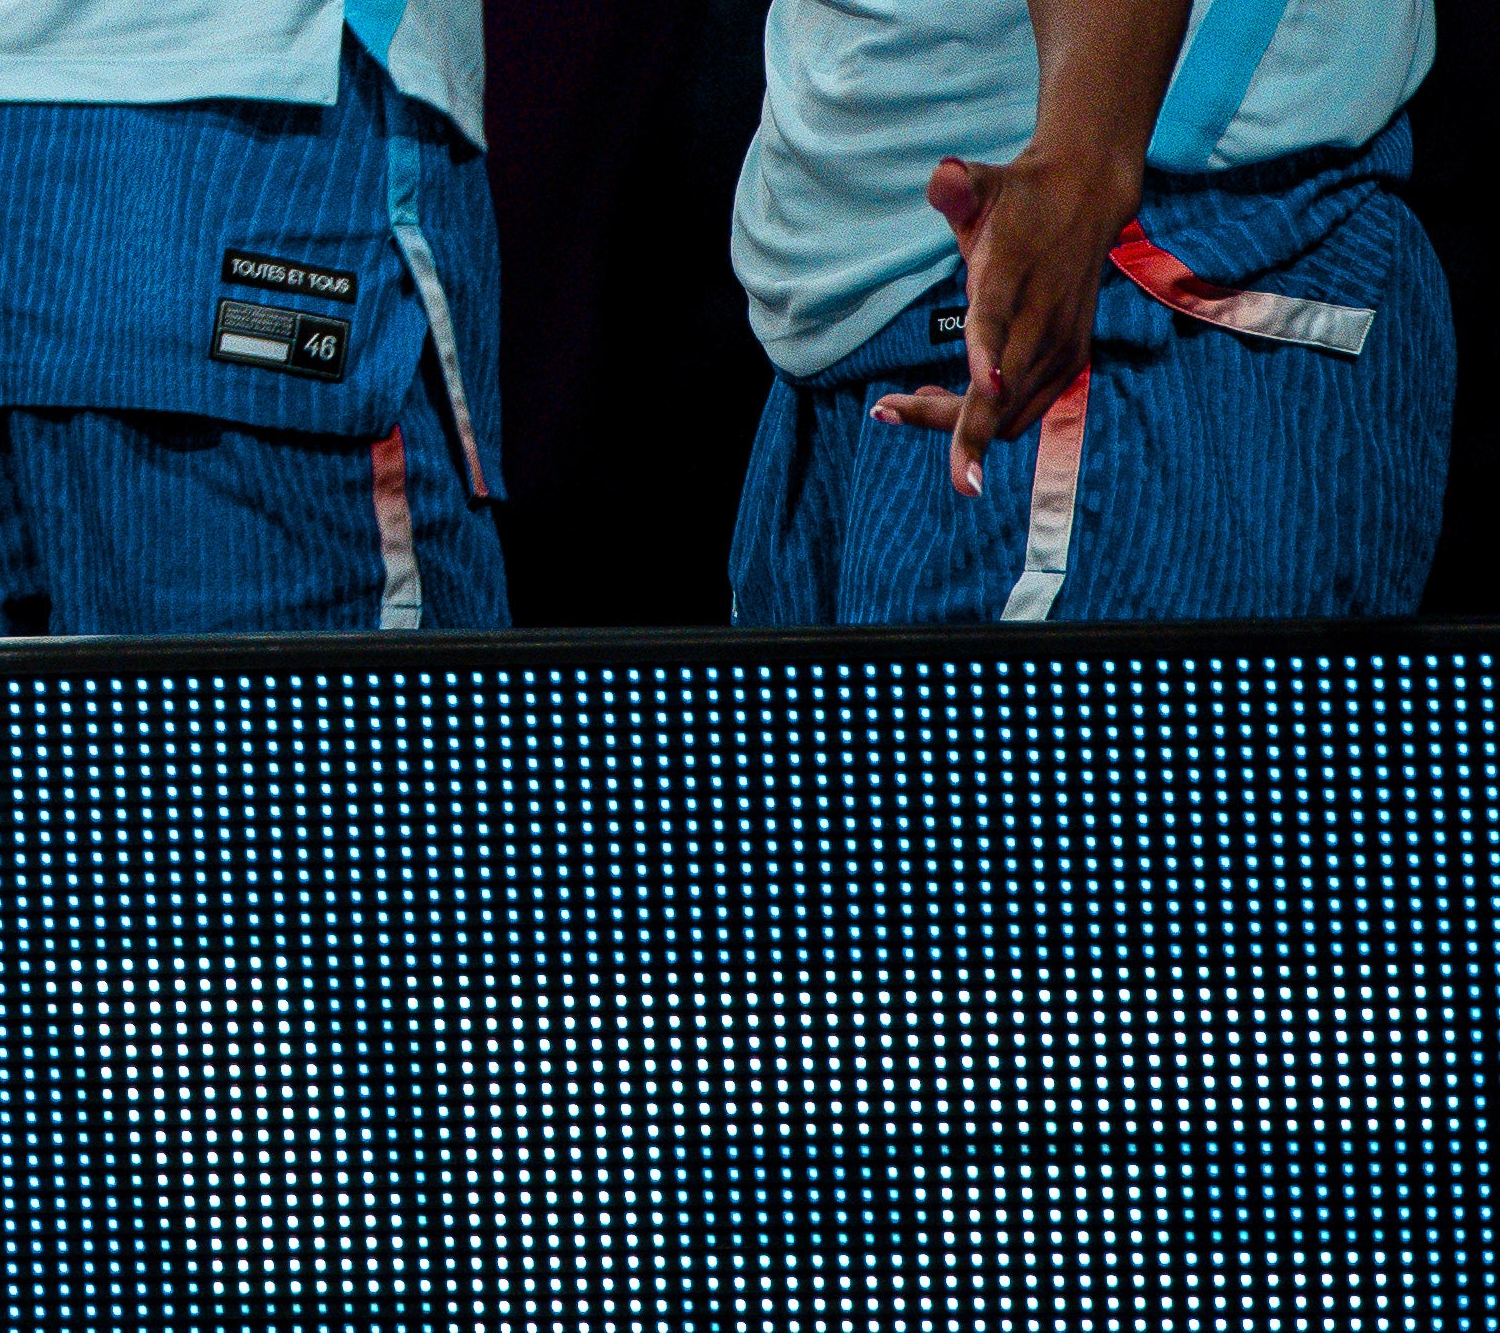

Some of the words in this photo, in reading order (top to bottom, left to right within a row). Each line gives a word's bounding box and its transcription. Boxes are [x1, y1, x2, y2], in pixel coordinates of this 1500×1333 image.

[231, 258, 286, 283] TOUTES
[287, 269, 305, 286] ET
[308, 273, 351, 294] TOUS
[303, 332, 338, 361] 46
